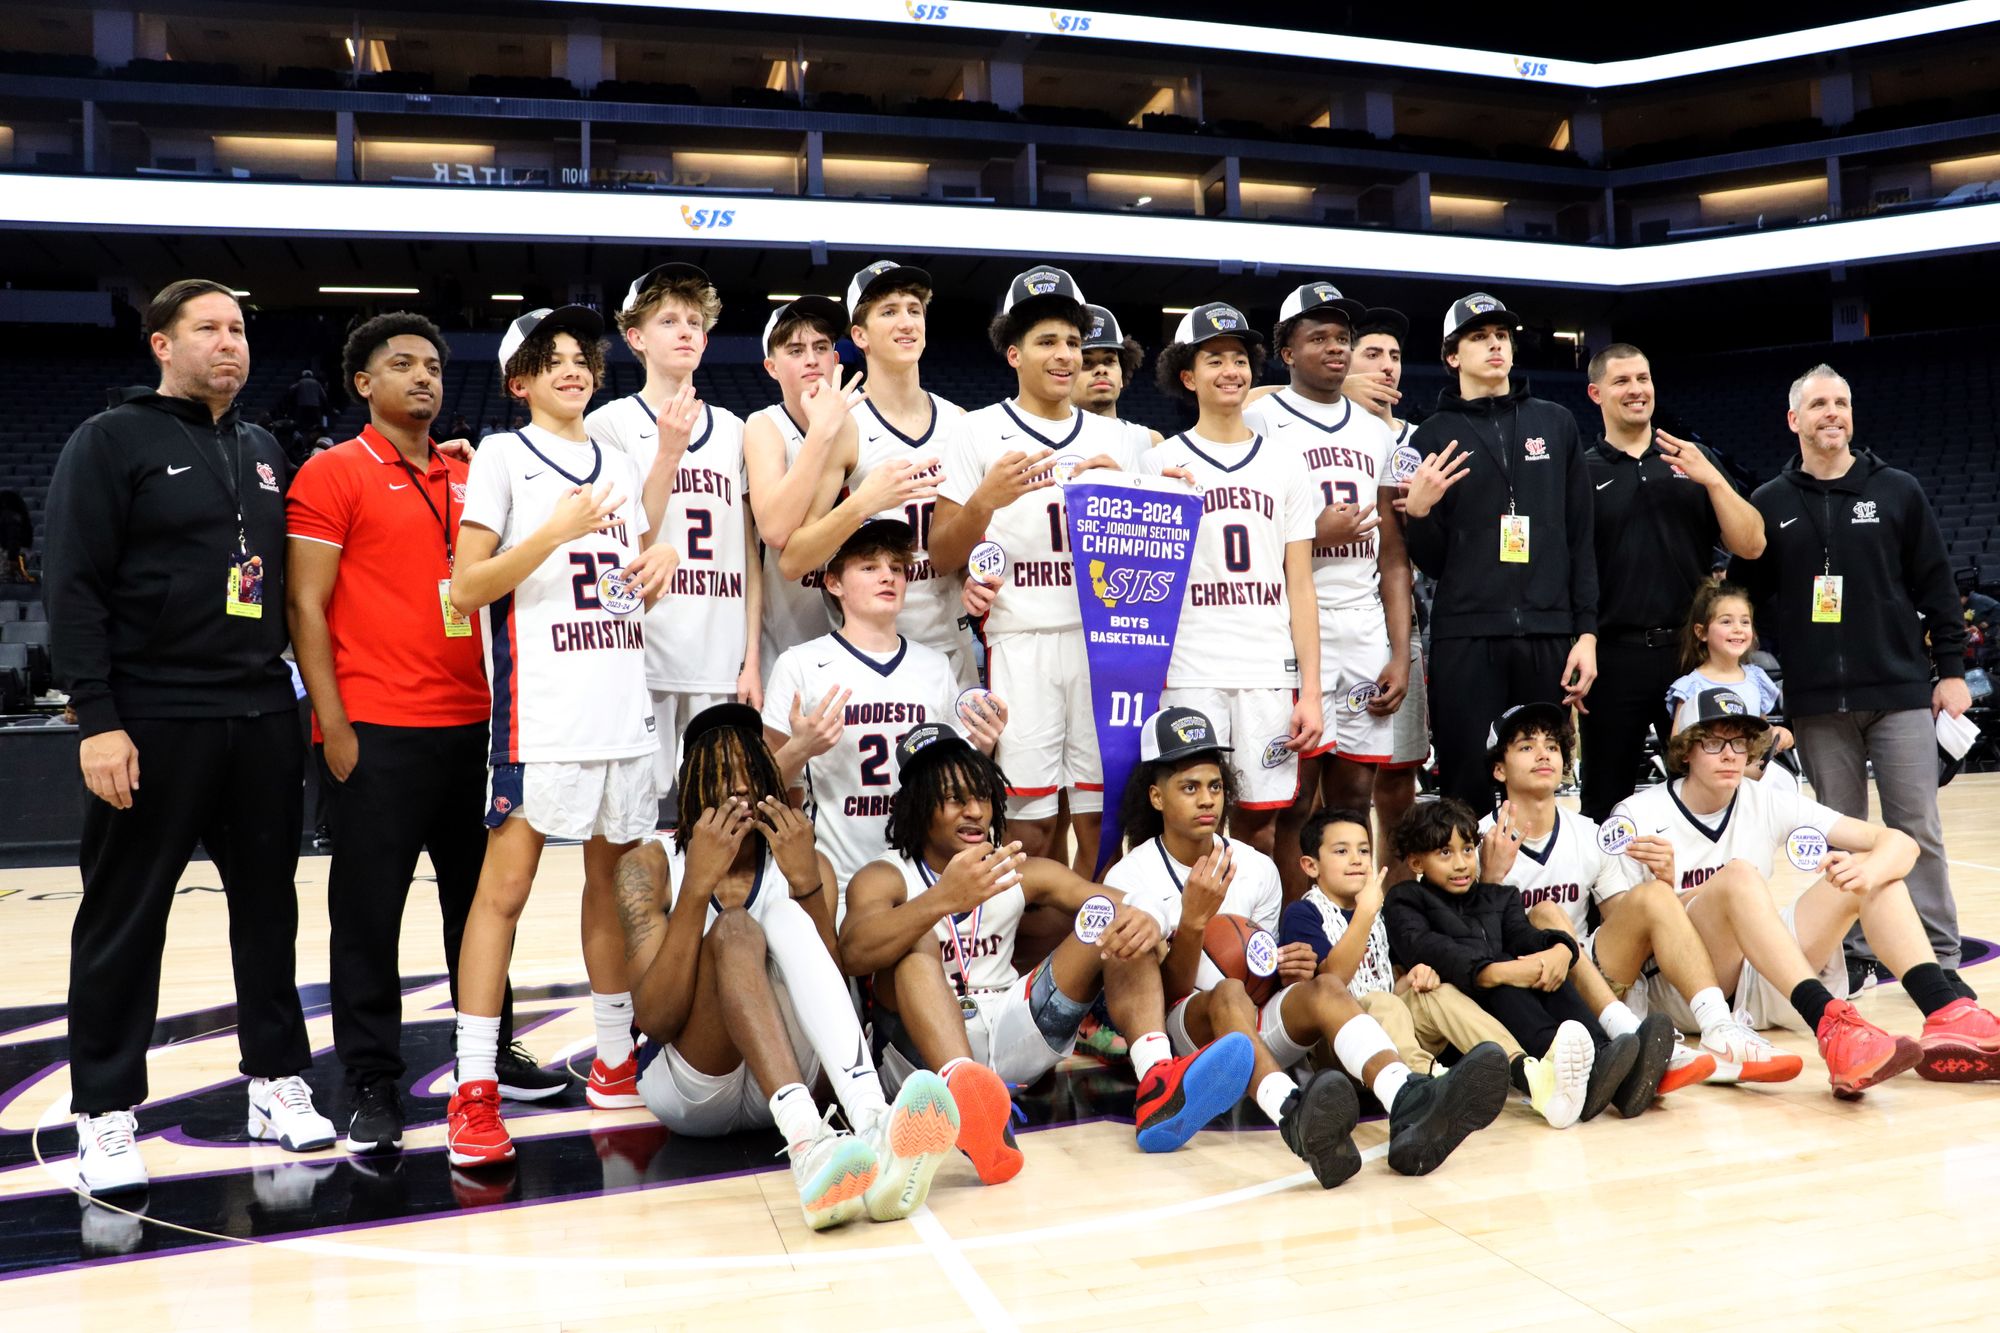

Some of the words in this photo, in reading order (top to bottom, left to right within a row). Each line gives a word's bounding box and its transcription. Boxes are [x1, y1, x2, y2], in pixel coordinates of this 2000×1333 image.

[914, 4, 948, 20] SJS
[1058, 16, 1091, 31] SJS
[1520, 61, 1548, 76] SJS
[691, 209, 736, 228] SJS
[671, 468, 732, 507] ODESTO
[1086, 496, 1183, 525] 2023-2024
[686, 508, 714, 561] 2
[1077, 519, 1148, 538] SAC-JOAQUIN
[1149, 525, 1190, 541] SECTION
[1082, 534, 1185, 560] CHAMPIONS
[1223, 524, 1251, 572] 0
[980, 552, 1000, 573] SJS
[1103, 568, 1175, 604] SJS
[1190, 582, 1282, 607] CHRISTIAN
[1110, 615, 1149, 629] BOYS
[551, 620, 644, 653] CHRISTIAN
[1090, 630, 1170, 646] BASKETBALL
[844, 702, 926, 726] MODESTO
[1110, 691, 1143, 727] D1
[1603, 825, 1625, 847] SJS
[1797, 844, 1823, 856] SJS
[1522, 883, 1579, 909] ODESTO
[1084, 914, 1110, 928] SJS
[1251, 940, 1268, 961] SJS
